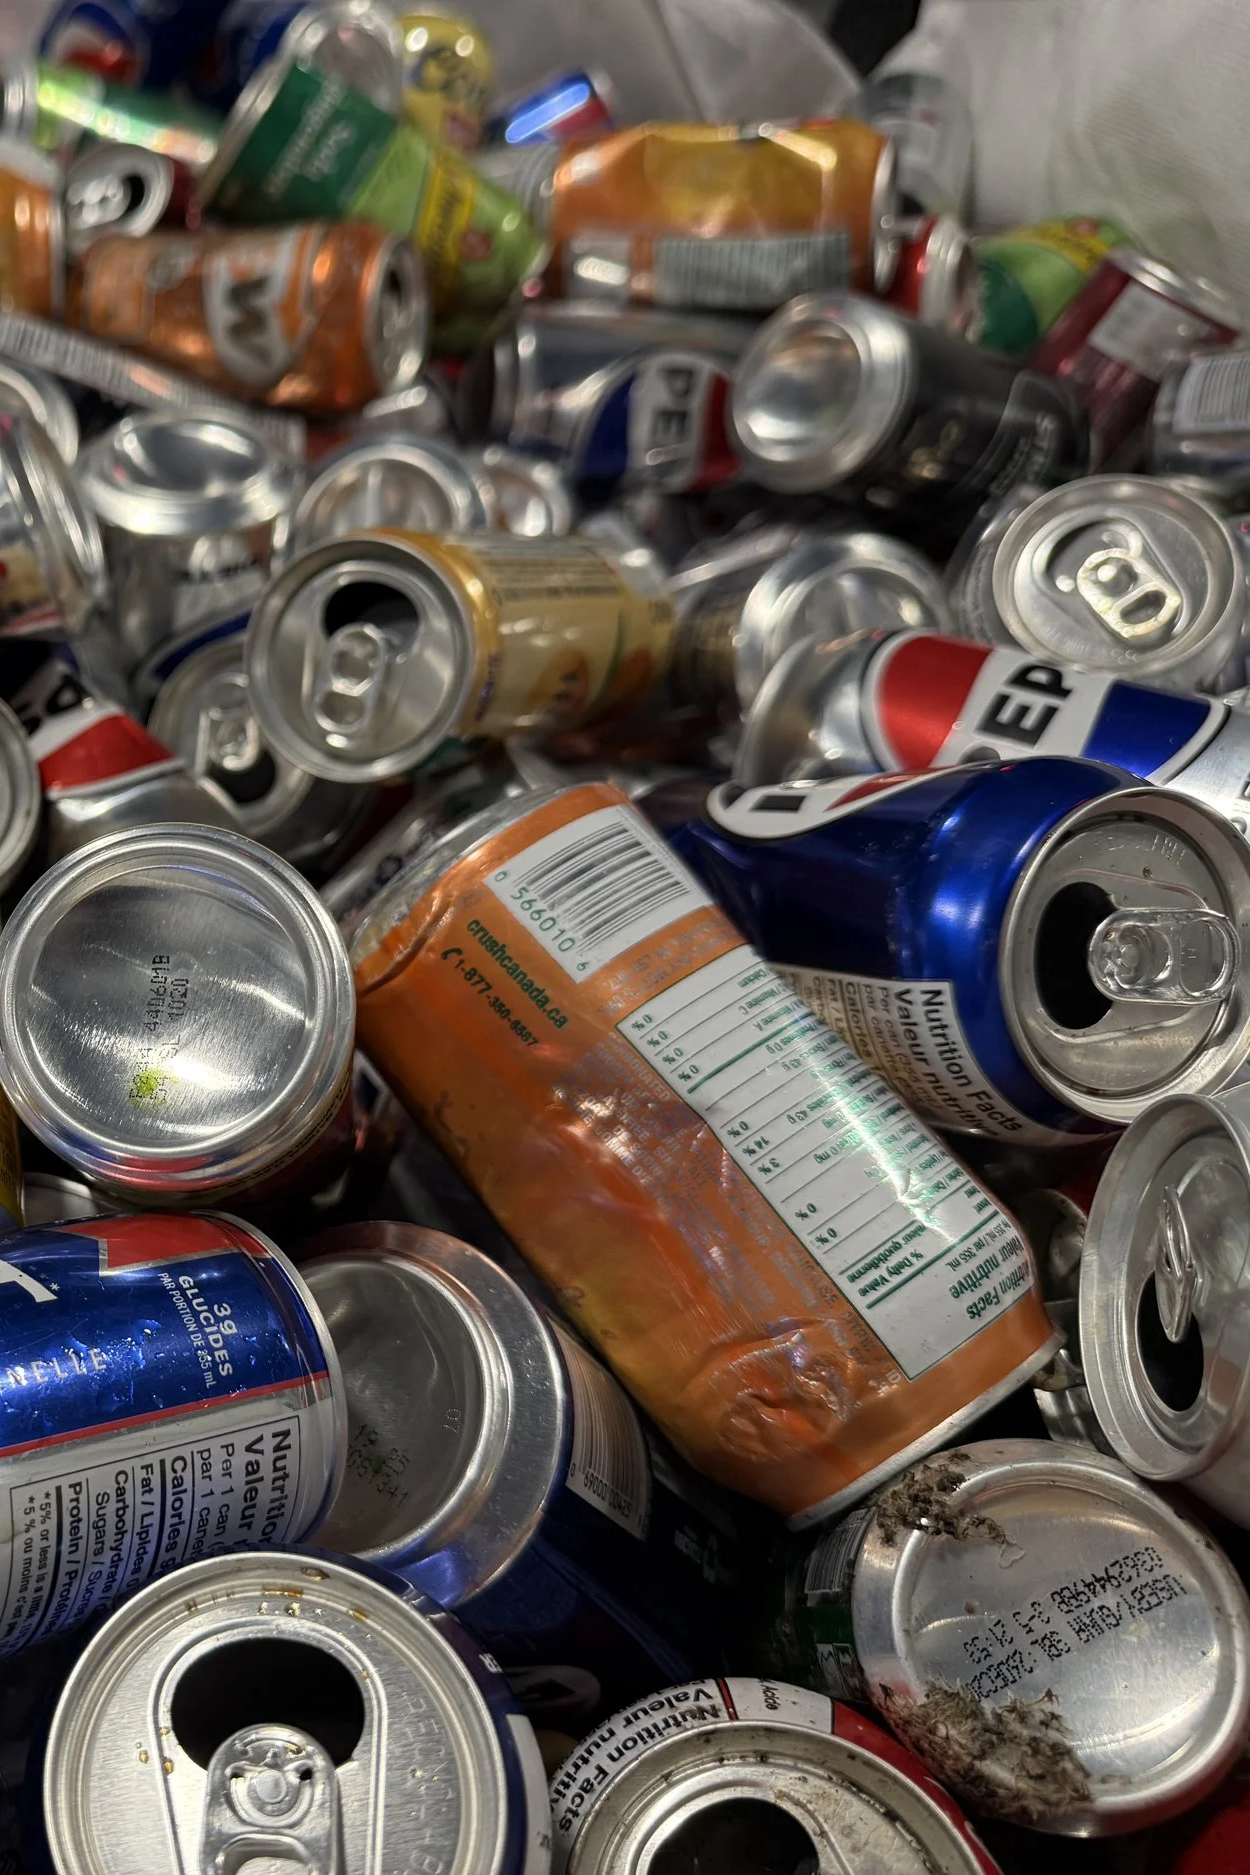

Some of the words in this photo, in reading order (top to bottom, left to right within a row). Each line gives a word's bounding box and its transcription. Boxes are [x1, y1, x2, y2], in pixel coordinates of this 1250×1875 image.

[955, 660, 1074, 765] PE
[490, 867, 509, 886] 0
[508, 882, 578, 957] 566010
[462, 914, 572, 1032] crushcanada.ca
[845, 982, 872, 1059] Calories
[893, 987, 931, 1067] Valeur
[925, 1072, 999, 1137] nutritive
[920, 988, 973, 1088] Nutrition
[966, 1090, 1023, 1132] Facts
[157, 1271, 180, 1290] PAR
[843, 1235, 905, 1289] quotidienne
[883, 1252, 913, 1281] Daily
[945, 1252, 1005, 1304] nutritive
[956, 1244, 977, 1264] 355
[167, 1288, 198, 1333] PORTION
[854, 1270, 890, 1302] Value
[962, 1285, 1005, 1323] Facts
[176, 1272, 234, 1377] GLUCIDES
[187, 1332, 205, 1348] DE
[201, 1370, 220, 1389] mL
[138, 1462, 155, 1497] Fat
[193, 1446, 213, 1483] par
[219, 1442, 236, 1481] Per
[237, 1432, 263, 1533] Valeur
[66, 1481, 84, 1555] Protein
[90, 1489, 109, 1557] Sugars
[165, 1453, 186, 1554] Calories
[213, 1501, 228, 1538] can
[101, 1468, 127, 1594] Carbohydrate
[131, 1510, 153, 1576] Lipides
[616, 1681, 715, 1733] Valeur
[760, 1683, 781, 1710] Acide
[602, 1698, 723, 1767] Nutrition
[552, 1760, 611, 1838] Facts
